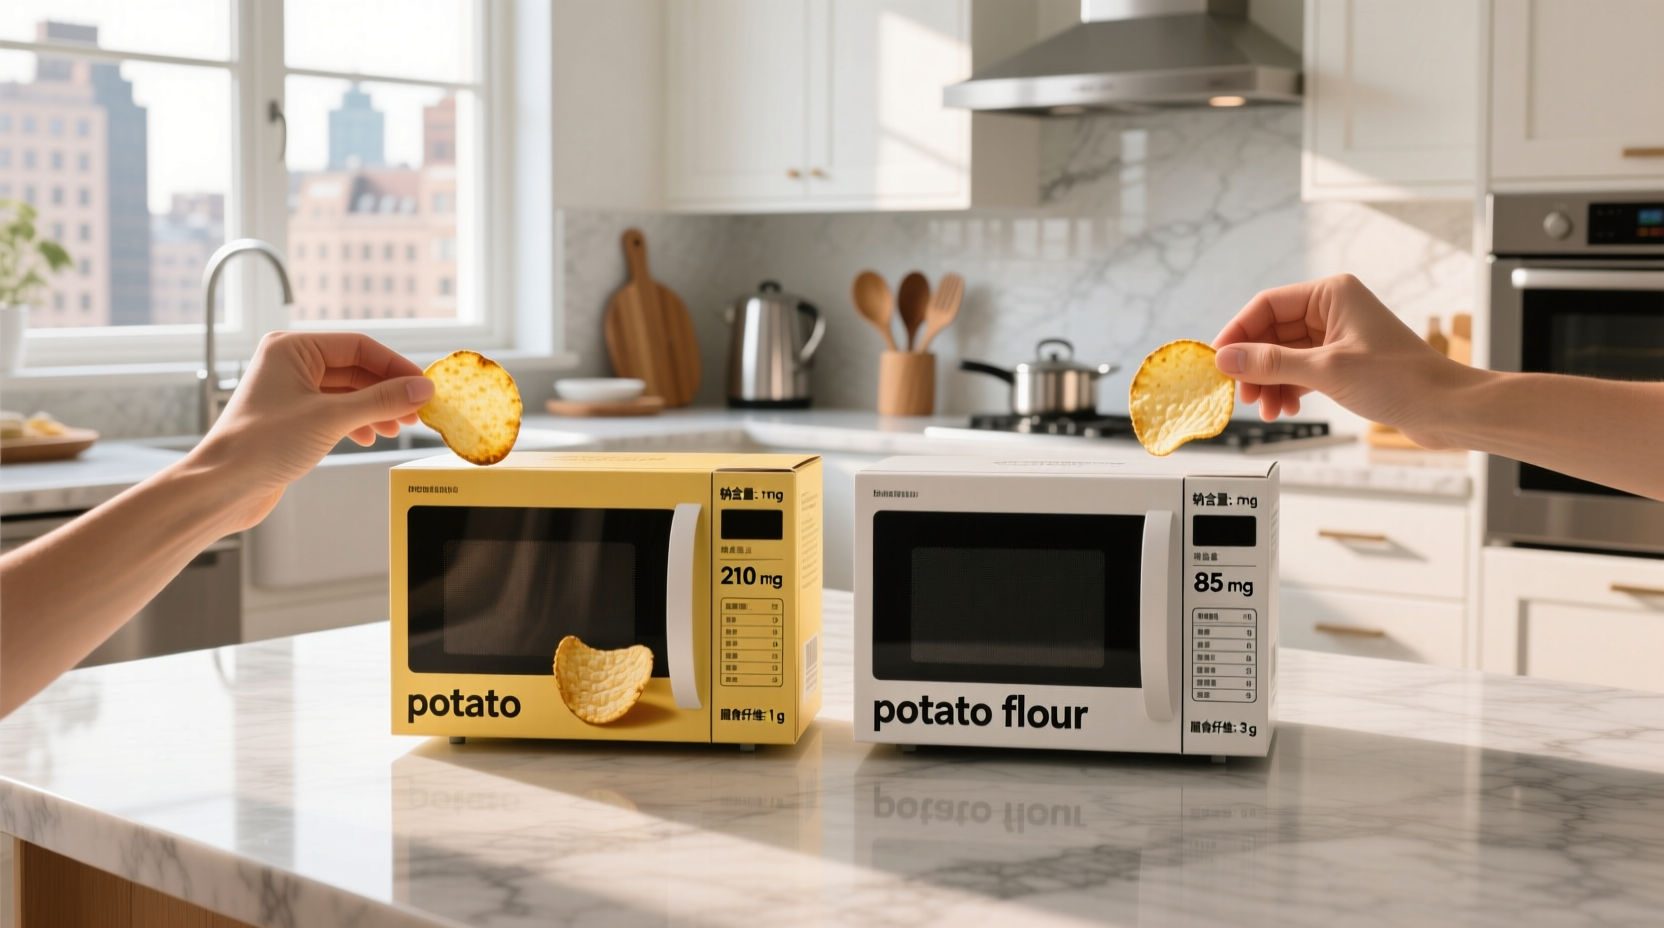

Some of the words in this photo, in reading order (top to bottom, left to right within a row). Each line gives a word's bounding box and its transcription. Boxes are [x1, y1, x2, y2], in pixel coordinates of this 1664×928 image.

[720, 565, 756, 586] 210
[760, 574, 783, 590] mg
[1193, 571, 1224, 593] 85
[1227, 581, 1254, 598] mg
[407, 688, 521, 724] potato
[873, 695, 993, 732] potato
[1001, 694, 1089, 730] flour
